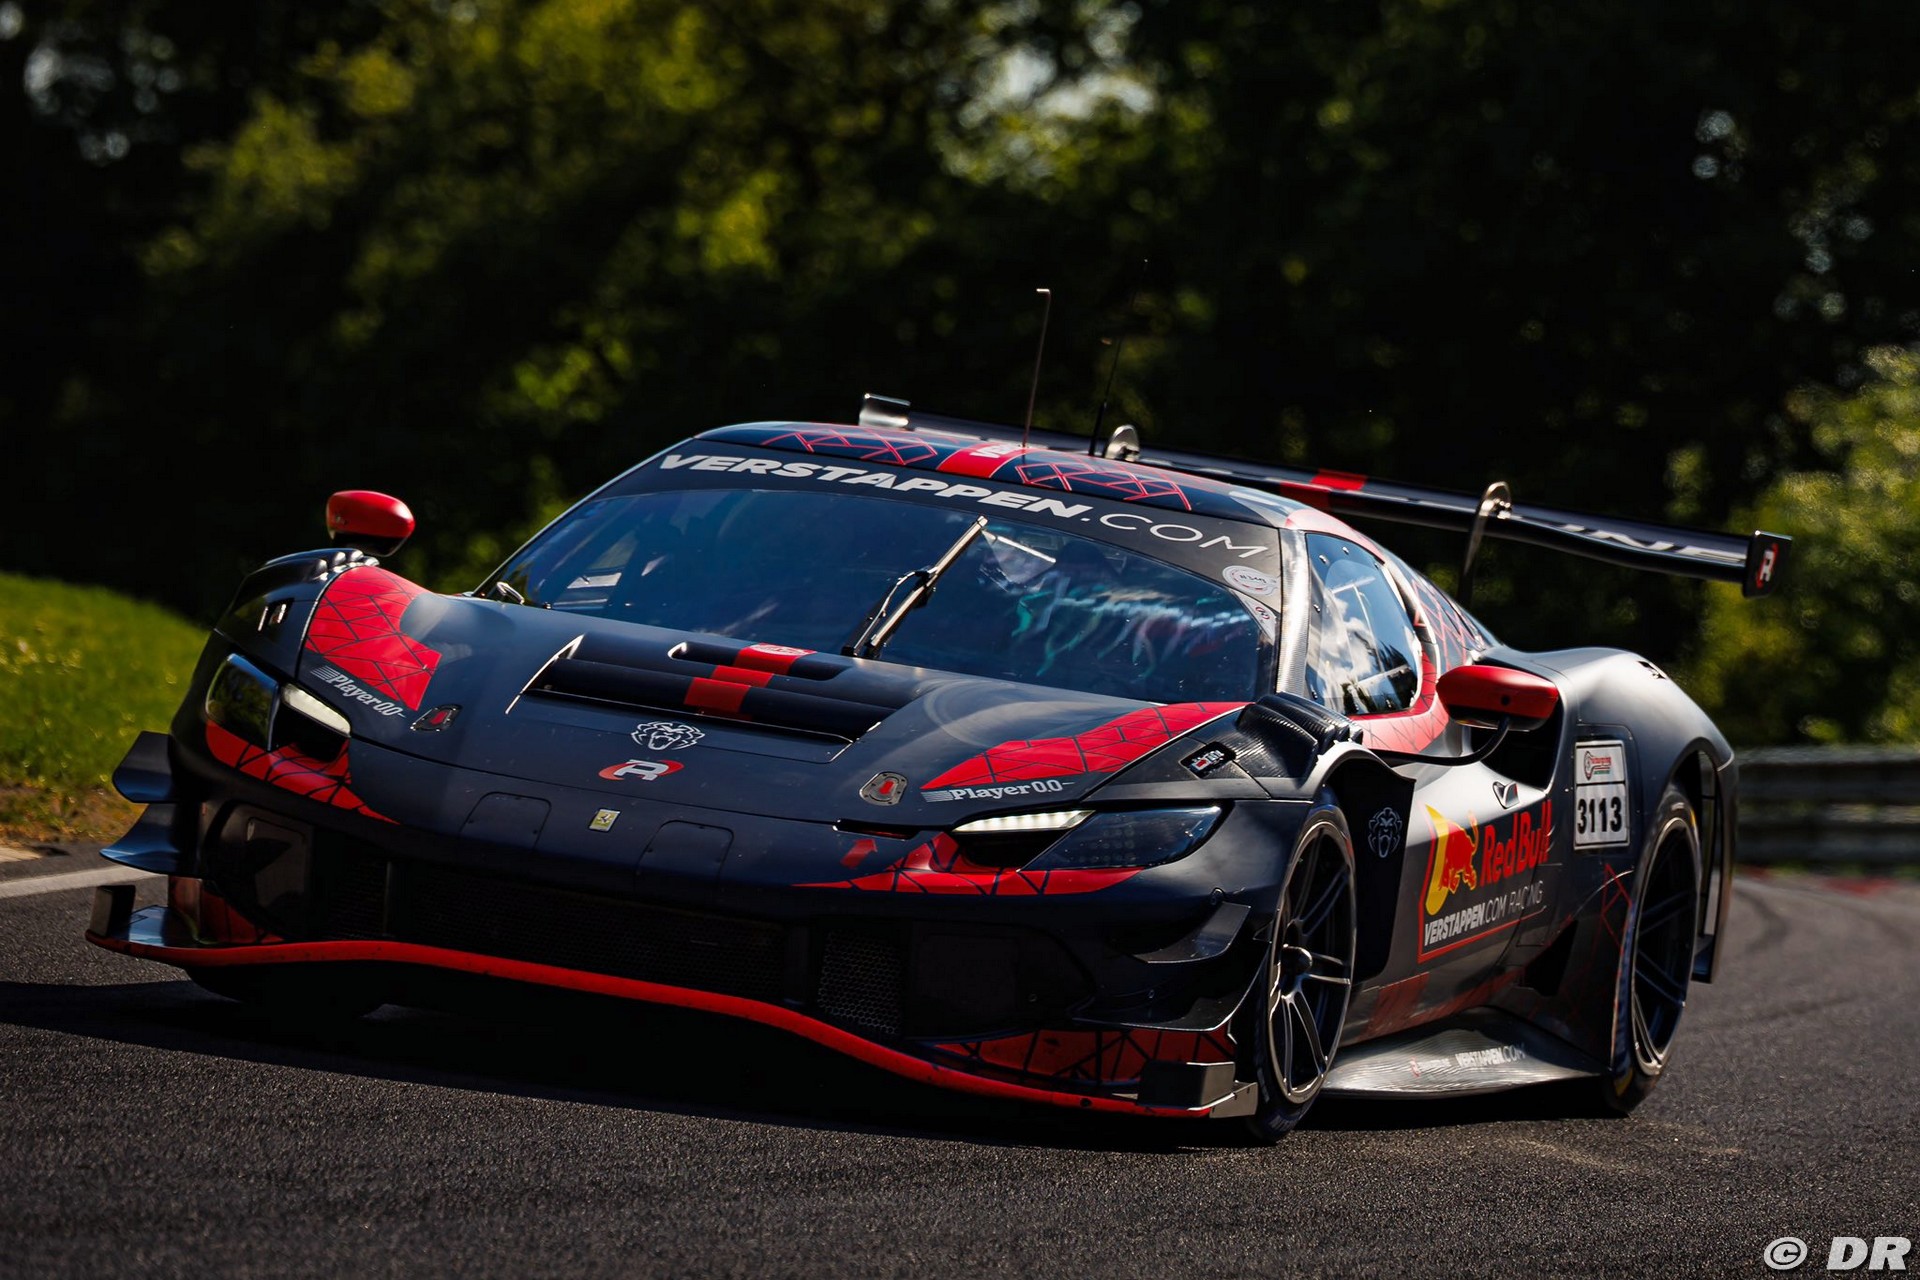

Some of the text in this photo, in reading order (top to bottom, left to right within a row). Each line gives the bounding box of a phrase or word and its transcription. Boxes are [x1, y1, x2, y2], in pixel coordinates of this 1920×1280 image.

[659, 454, 1270, 560] VERSTAPPEN.COM
[326, 674, 381, 706] Player
[950, 784, 1031, 801] Player
[1577, 796, 1622, 835] 3113
[1424, 880, 1543, 946] VERSTAPPEN.COM RACING
